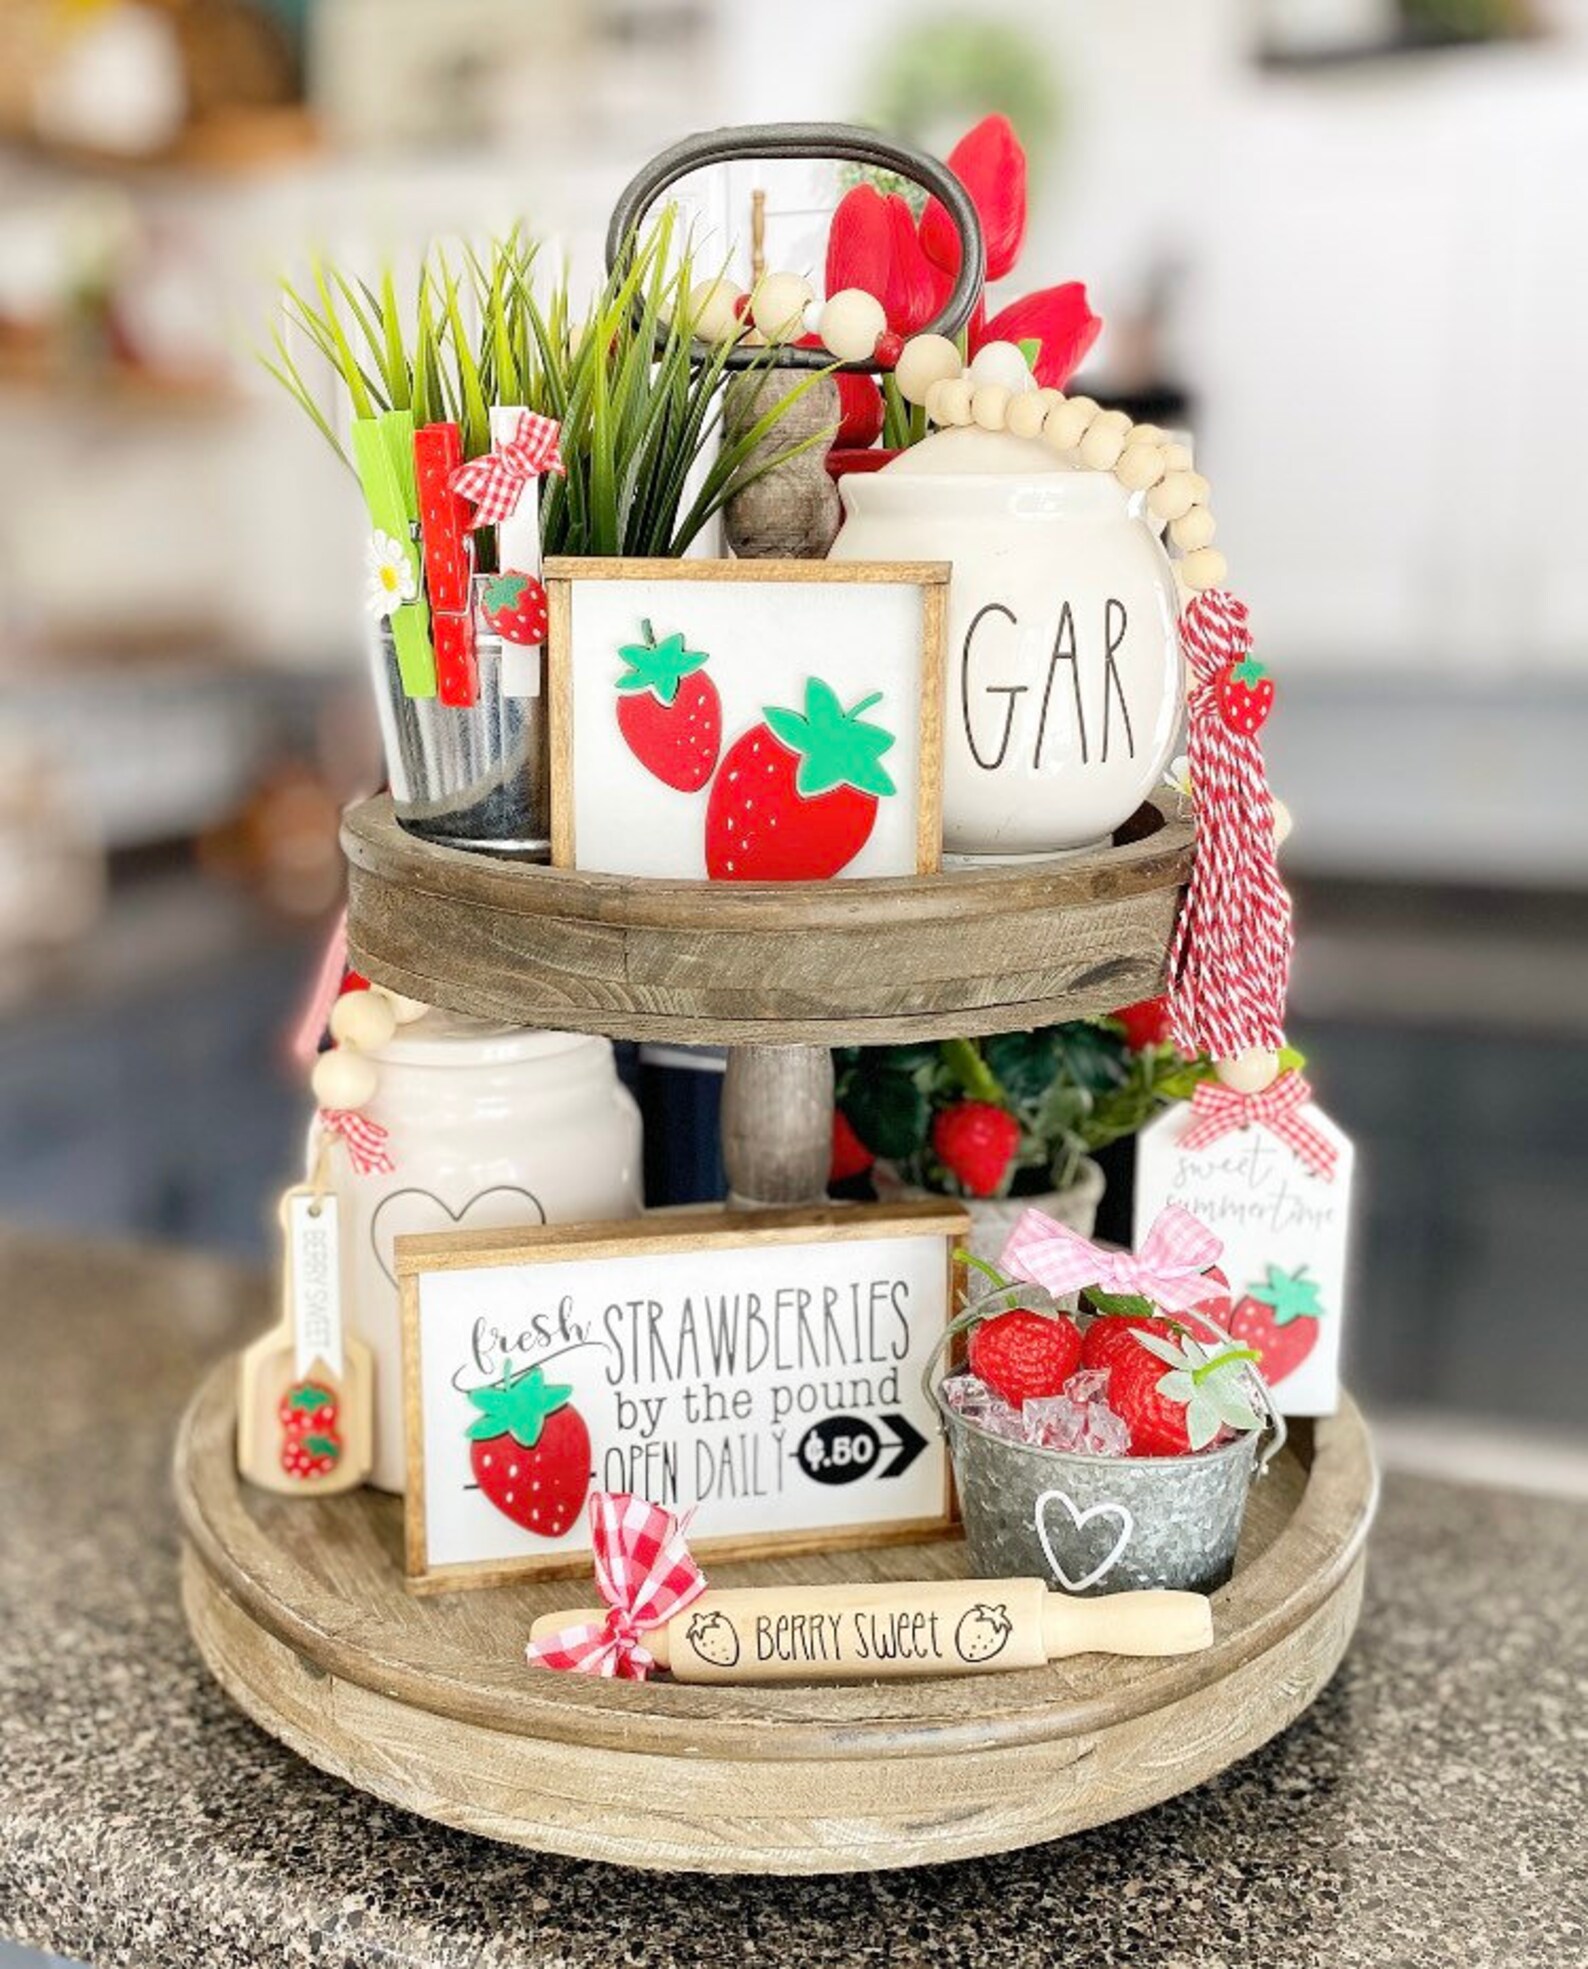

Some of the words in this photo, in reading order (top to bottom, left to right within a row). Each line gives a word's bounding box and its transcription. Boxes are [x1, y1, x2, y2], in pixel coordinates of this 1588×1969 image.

[960, 598, 1135, 770] GAR
[1173, 1134, 1278, 1189] sweet
[302, 1229, 328, 1286] BERRY
[304, 1288, 331, 1348] SWEET
[471, 1294, 592, 1375] fresh
[603, 1279, 910, 1386] STRAWBERRIES
[614, 1391, 667, 1438] by
[683, 1384, 752, 1424] the
[770, 1367, 902, 1424] pound
[604, 1441, 678, 1506] OPEN
[696, 1429, 785, 1502] DAILY
